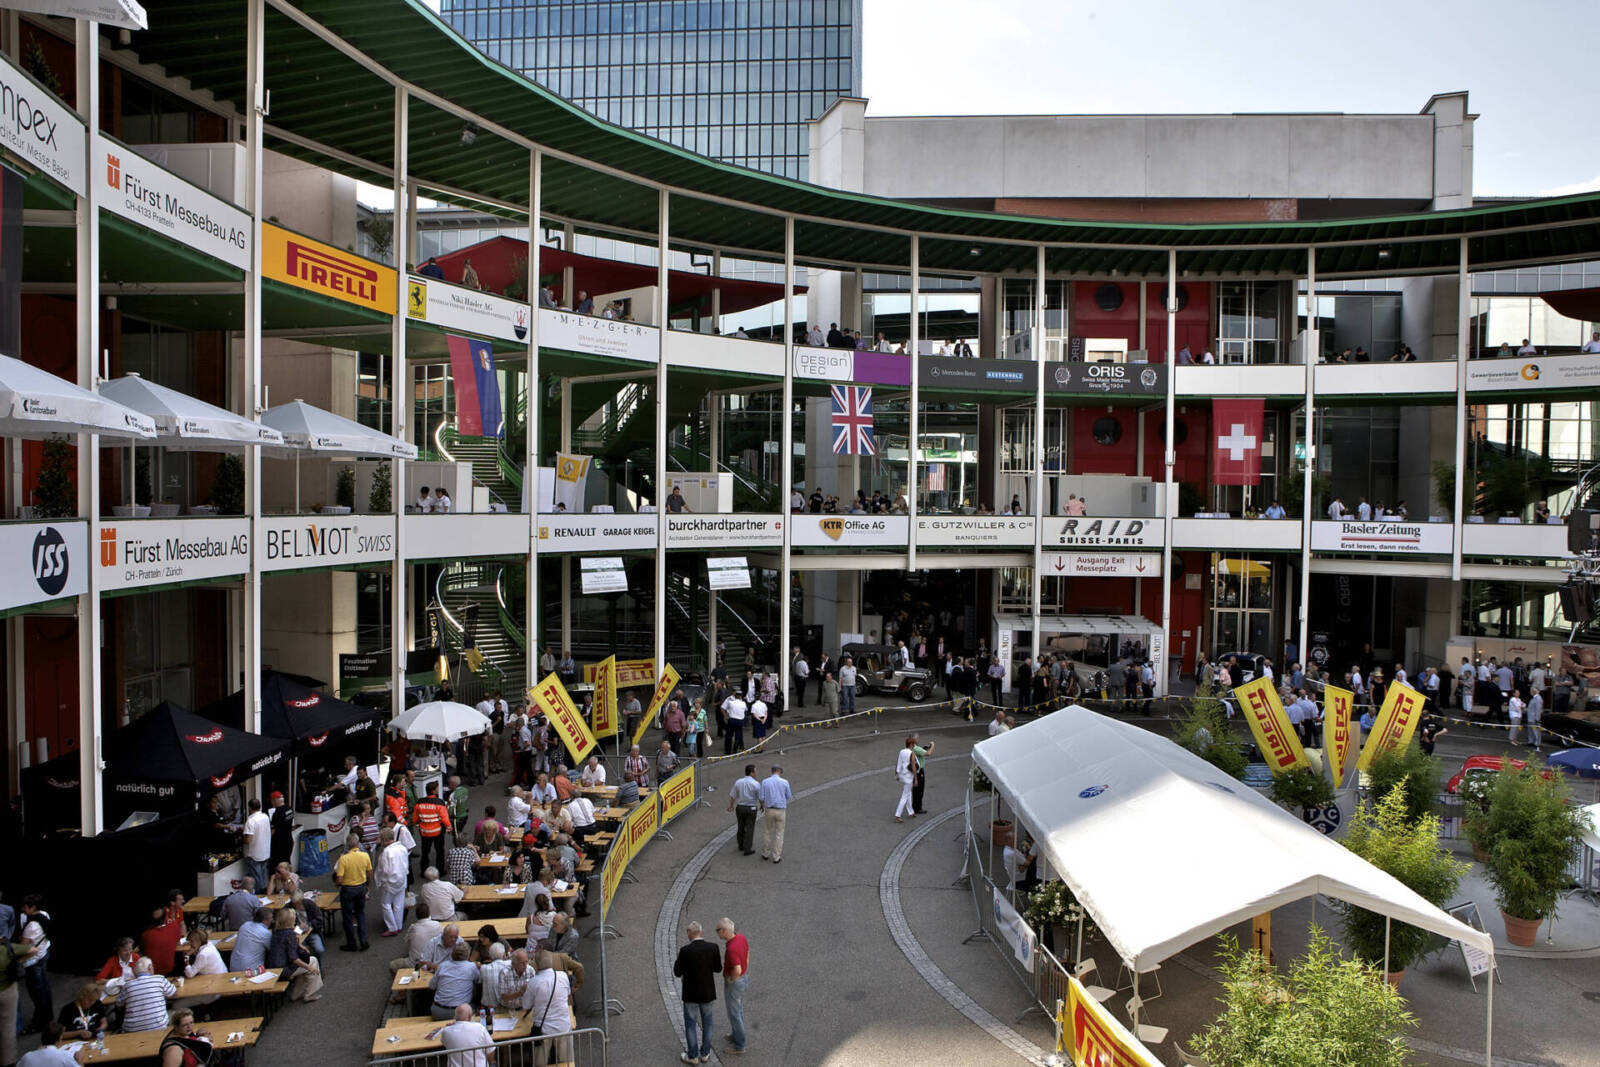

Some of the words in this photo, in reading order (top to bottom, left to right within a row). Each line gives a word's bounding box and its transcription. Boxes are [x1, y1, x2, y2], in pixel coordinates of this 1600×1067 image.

[27, 143, 50, 168] Messe
[52, 158, 69, 179] Basel
[125, 173, 161, 210] Fürst
[165, 193, 226, 240] Messebau
[229, 227, 245, 250] AG
[125, 199, 152, 219] CH-4133
[152, 211, 175, 229] Pratteln
[287, 240, 378, 302] PIRELLI
[451, 293, 464, 304] Niki
[484, 303, 493, 311] AG
[801, 364, 826, 375] TEC
[1088, 365, 1125, 378] ORIS
[668, 518, 767, 532] burckhardtpartner
[823, 520, 843, 530] KTR
[844, 520, 870, 530] Office
[872, 521, 885, 530] AG
[918, 521, 930, 529] E.
[932, 521, 1006, 530] GUTZWILLER
[1008, 521, 1016, 529] &
[1060, 519, 1144, 536] RAID
[1342, 523, 1378, 534] Basler
[1378, 523, 1421, 537] Zeitung
[554, 527, 597, 538] RENAULT
[603, 527, 632, 537] GARAGE
[633, 527, 656, 536] KEIGEL
[267, 524, 352, 559] BELMOT
[357, 535, 392, 553] SWISS
[1060, 536, 1144, 545] SUISSE-PARIS
[125, 540, 161, 564] Fürst
[166, 536, 227, 561] Messebau
[230, 534, 248, 556] AG
[36, 543, 66, 579] ISS
[1076, 556, 1111, 565] Ausgang
[1111, 556, 1125, 565] Exit
[165, 566, 183, 578] Zürich
[1076, 564, 1117, 573] Messeplatz
[1369, 692, 1415, 767] PRELLI
[273, 751, 282, 764] gut
[116, 783, 156, 795] natürlich
[158, 785, 175, 797] gut
[663, 777, 692, 812] PRELLI
[631, 803, 656, 845] PIRELLI
